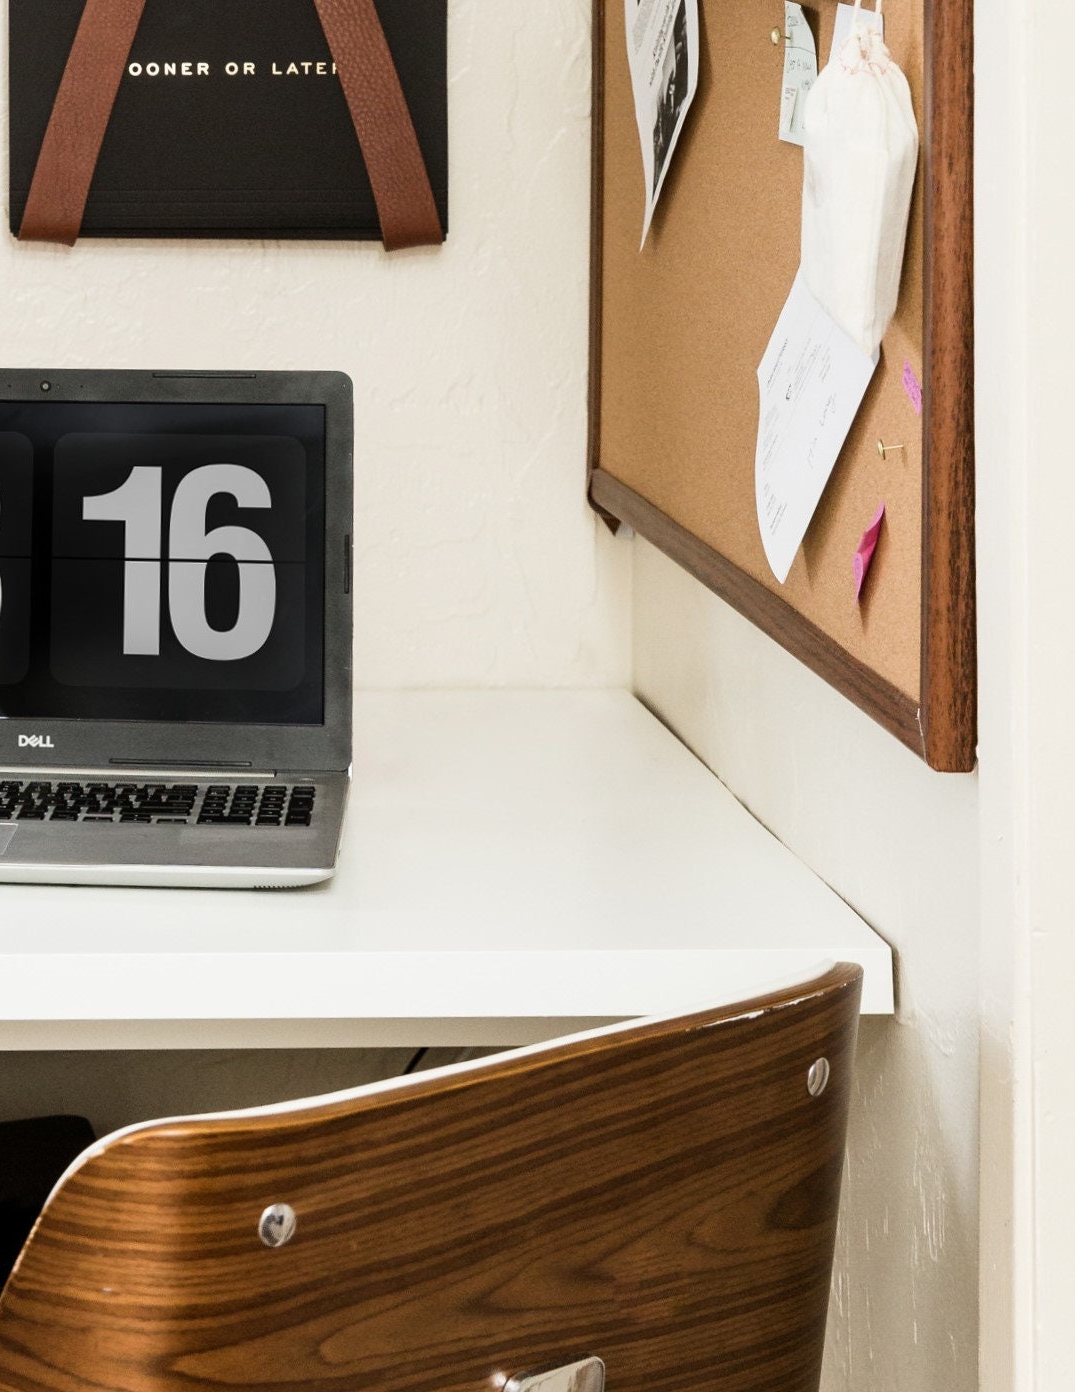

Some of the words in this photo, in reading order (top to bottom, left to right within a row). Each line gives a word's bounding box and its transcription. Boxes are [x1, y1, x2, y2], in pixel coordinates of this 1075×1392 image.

[128, 62, 210, 76] OONER
[225, 61, 255, 76] OR
[81, 463, 278, 662] 16
[18, 734, 54, 747] DELL
